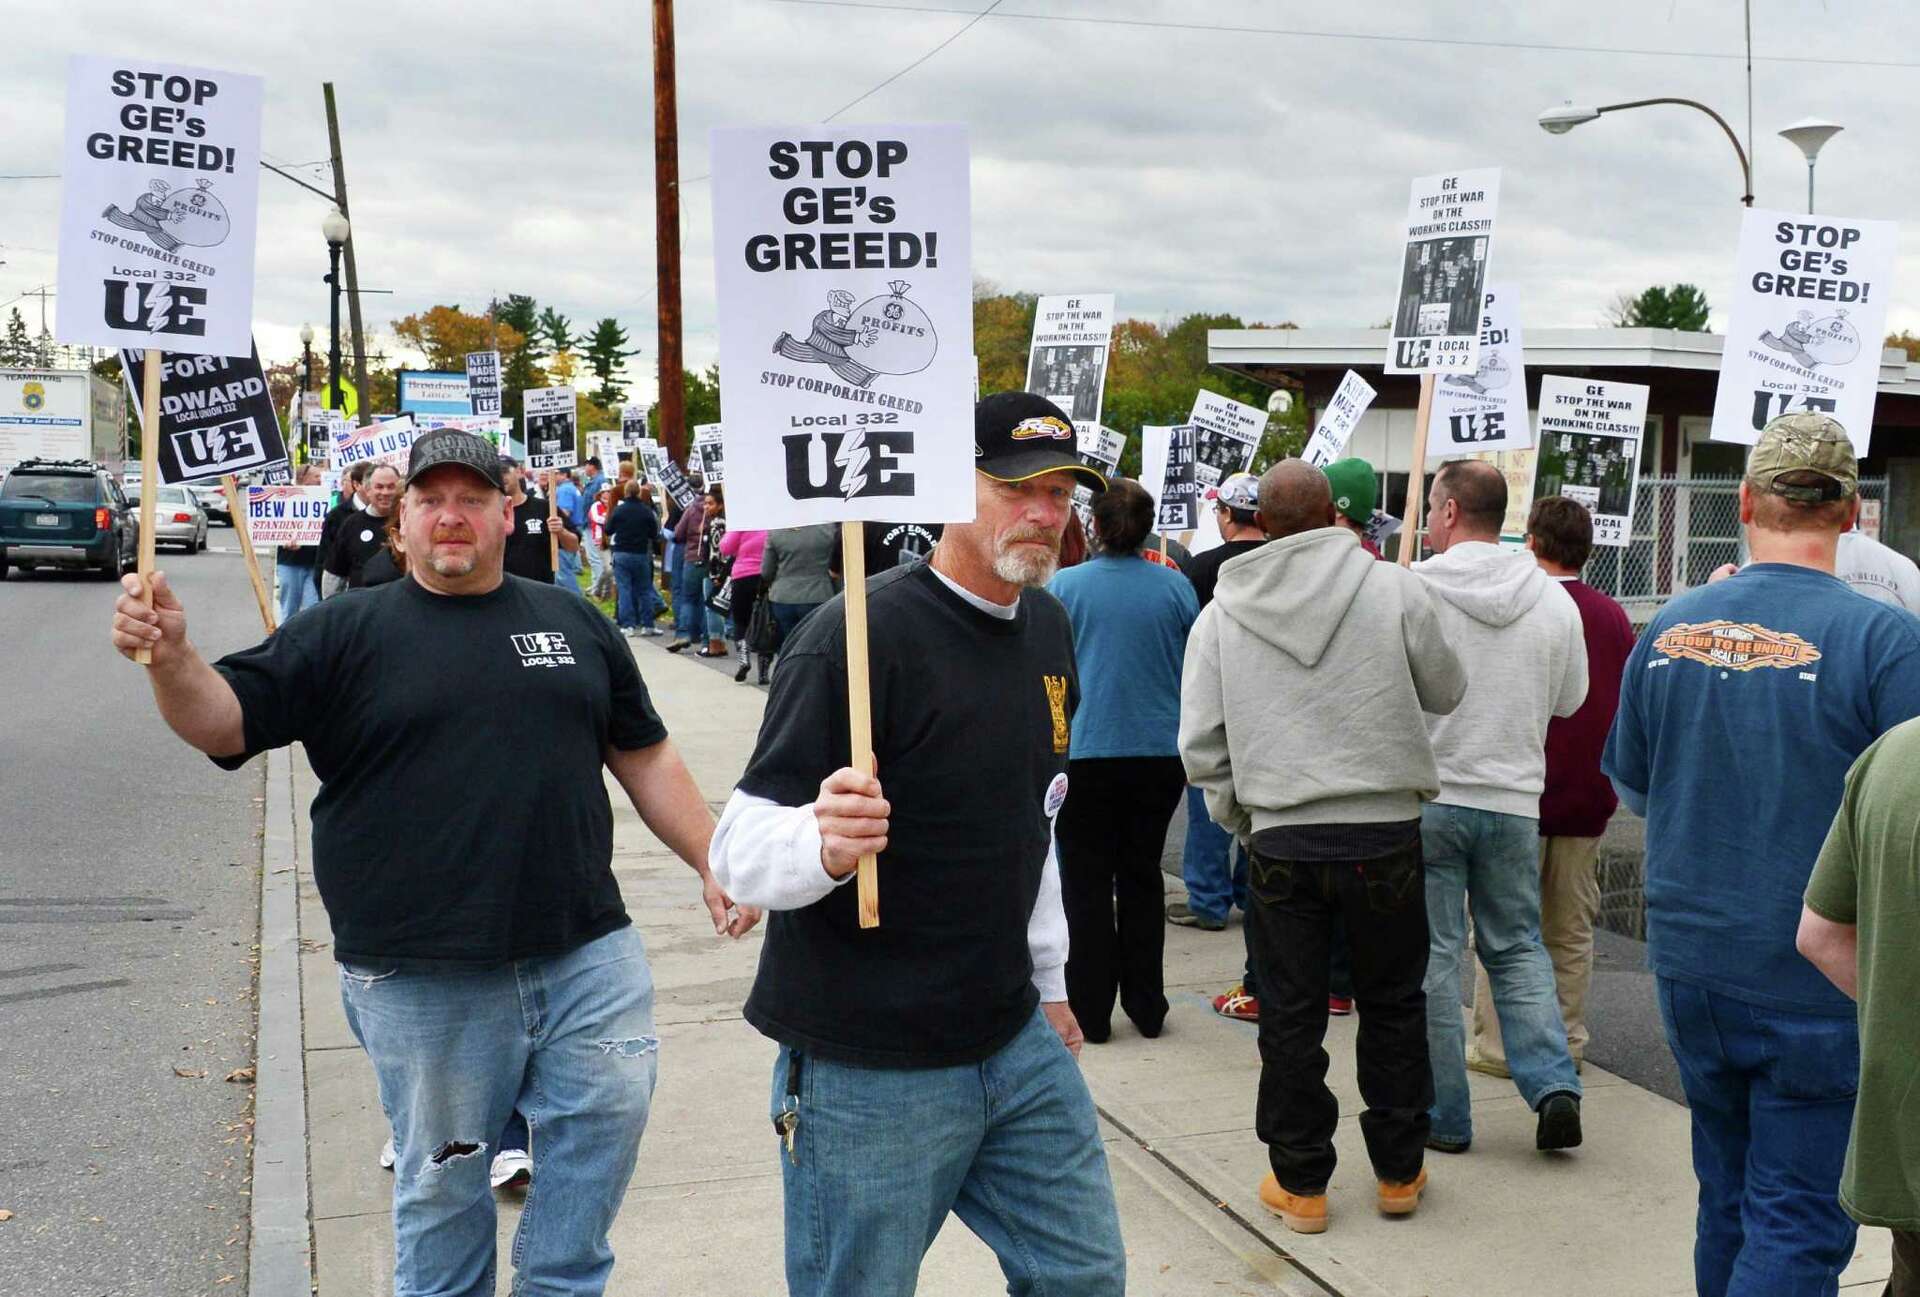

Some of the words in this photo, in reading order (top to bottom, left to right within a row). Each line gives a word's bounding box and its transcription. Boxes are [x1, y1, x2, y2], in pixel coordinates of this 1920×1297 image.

[111, 70, 218, 105] STOP
[120, 104, 205, 137] GE's
[87, 132, 235, 173] GREED!
[768, 141, 908, 180] STOP
[1442, 177, 1458, 190] GE
[783, 186, 896, 224] GE's
[1420, 196, 1440, 208] STOP
[1442, 194, 1458, 204] THE
[1460, 191, 1484, 202] WAR
[174, 200, 221, 221] PROFITS
[1433, 210, 1444, 219] ON
[1446, 207, 1462, 217] THE
[1409, 223, 1446, 236] WORKING
[1448, 220, 1492, 232] CLASS!!!
[1776, 222, 1860, 249] STOP
[90, 230, 118, 246] STOP
[120, 239, 179, 267] CORPORATE
[182, 258, 216, 276] GREED
[745, 232, 937, 272] GREED!
[1780, 250, 1848, 276] GE's
[112, 266, 156, 278] Local
[164, 270, 196, 282] 332
[1752, 272, 1870, 304] GREED!
[104, 279, 207, 336] UE
[1068, 300, 1081, 308] GE
[1046, 312, 1065, 320] STOP
[1067, 312, 1080, 320] THE
[1082, 311, 1102, 319] WAR
[861, 315, 925, 338] PROFITS
[1058, 323, 1068, 331] ON
[1070, 322, 1085, 330] THE
[1036, 334, 1072, 342] WORKING
[1438, 341, 1470, 350] LOCAL
[1480, 329, 1510, 345] ED!
[1396, 340, 1432, 368] UE
[1748, 350, 1769, 363] STOP
[1770, 357, 1816, 382] CORPORATE
[1818, 376, 1845, 390] GREED
[760, 371, 795, 388] STOP
[797, 376, 875, 404] CORPORATE
[878, 394, 923, 414] GREED
[1586, 386, 1604, 396] GE
[1762, 379, 1796, 391] Local
[1802, 384, 1828, 394] 332
[160, 377, 264, 416] DWARD
[1556, 396, 1583, 404] STOP
[1587, 398, 1604, 408] THE
[1607, 400, 1632, 410] WAR
[175, 408, 199, 423] LOCAL
[200, 405, 222, 420] UNION
[224, 402, 237, 414] 332
[1205, 404, 1222, 414] STOP
[1225, 412, 1237, 420] THE
[1239, 417, 1256, 426] WAR
[1227, 402, 1238, 412] GE
[1574, 408, 1590, 418] ON
[1593, 410, 1610, 420] THE
[791, 414, 848, 428] Local
[856, 412, 898, 424] 332
[1194, 416, 1227, 432] WORKING
[1226, 420, 1240, 428] THE
[1450, 412, 1506, 443] UE
[1542, 417, 1594, 430] WORKING
[1596, 422, 1640, 434] CLASS!!!
[1076, 425, 1090, 433] CAL
[174, 420, 256, 469] UE
[1180, 430, 1192, 446] IT
[341, 441, 376, 463] IBEW
[380, 435, 396, 452] LU
[399, 431, 414, 448] 97
[1179, 448, 1192, 463] IN
[531, 456, 554, 468] UE
[782, 430, 915, 500] UE
[1167, 466, 1184, 476] RT
[250, 501, 285, 518] IBEW
[293, 501, 308, 518] LU
[313, 501, 328, 518] 97
[253, 520, 304, 530] STANDING
[1594, 518, 1622, 528] OCAL
[883, 525, 906, 546] FORT
[907, 524, 938, 547] EDWAR
[510, 632, 571, 656] UE
[1670, 635, 1712, 647] PROUD
[1714, 637, 1734, 650] TO
[1736, 640, 1752, 652] BE
[1754, 642, 1794, 657] UNION
[522, 657, 557, 668] LOCAL
[557, 656, 576, 665] 332
[1710, 648, 1732, 664] LOCAL
